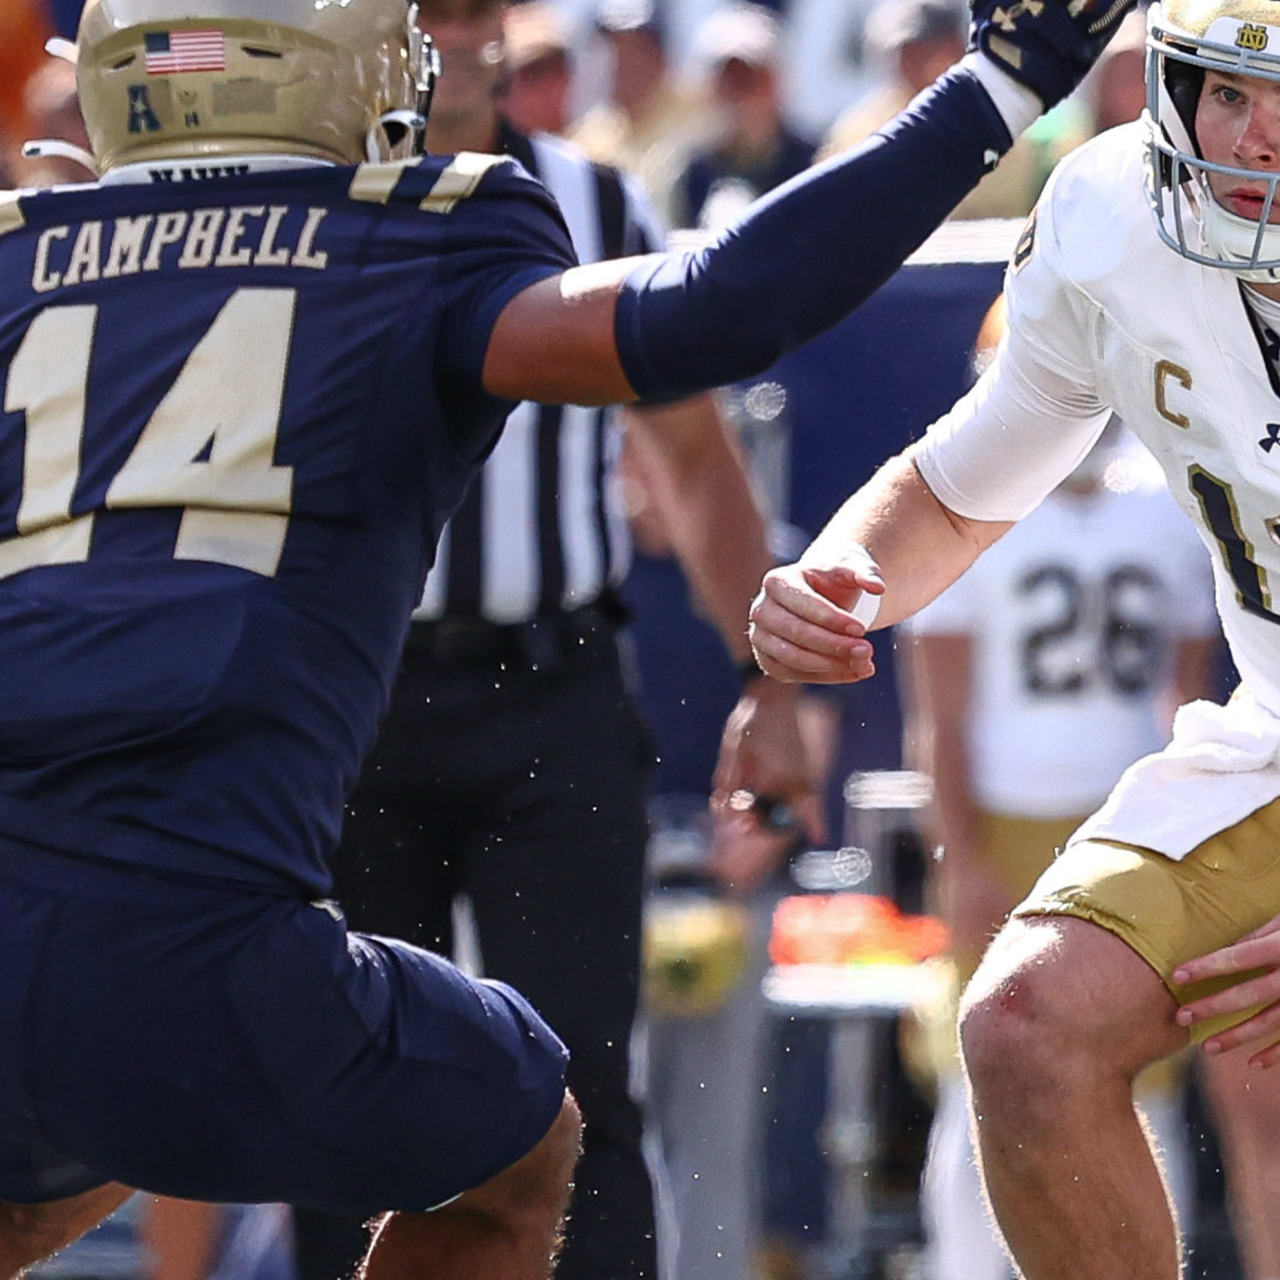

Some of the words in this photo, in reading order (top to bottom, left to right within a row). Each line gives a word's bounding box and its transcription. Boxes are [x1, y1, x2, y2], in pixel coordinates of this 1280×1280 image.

[31, 205, 329, 294] CAMPBELL
[0, 286, 297, 579] 14
[1154, 358, 1193, 429] C
[1014, 562, 1166, 700] 26
